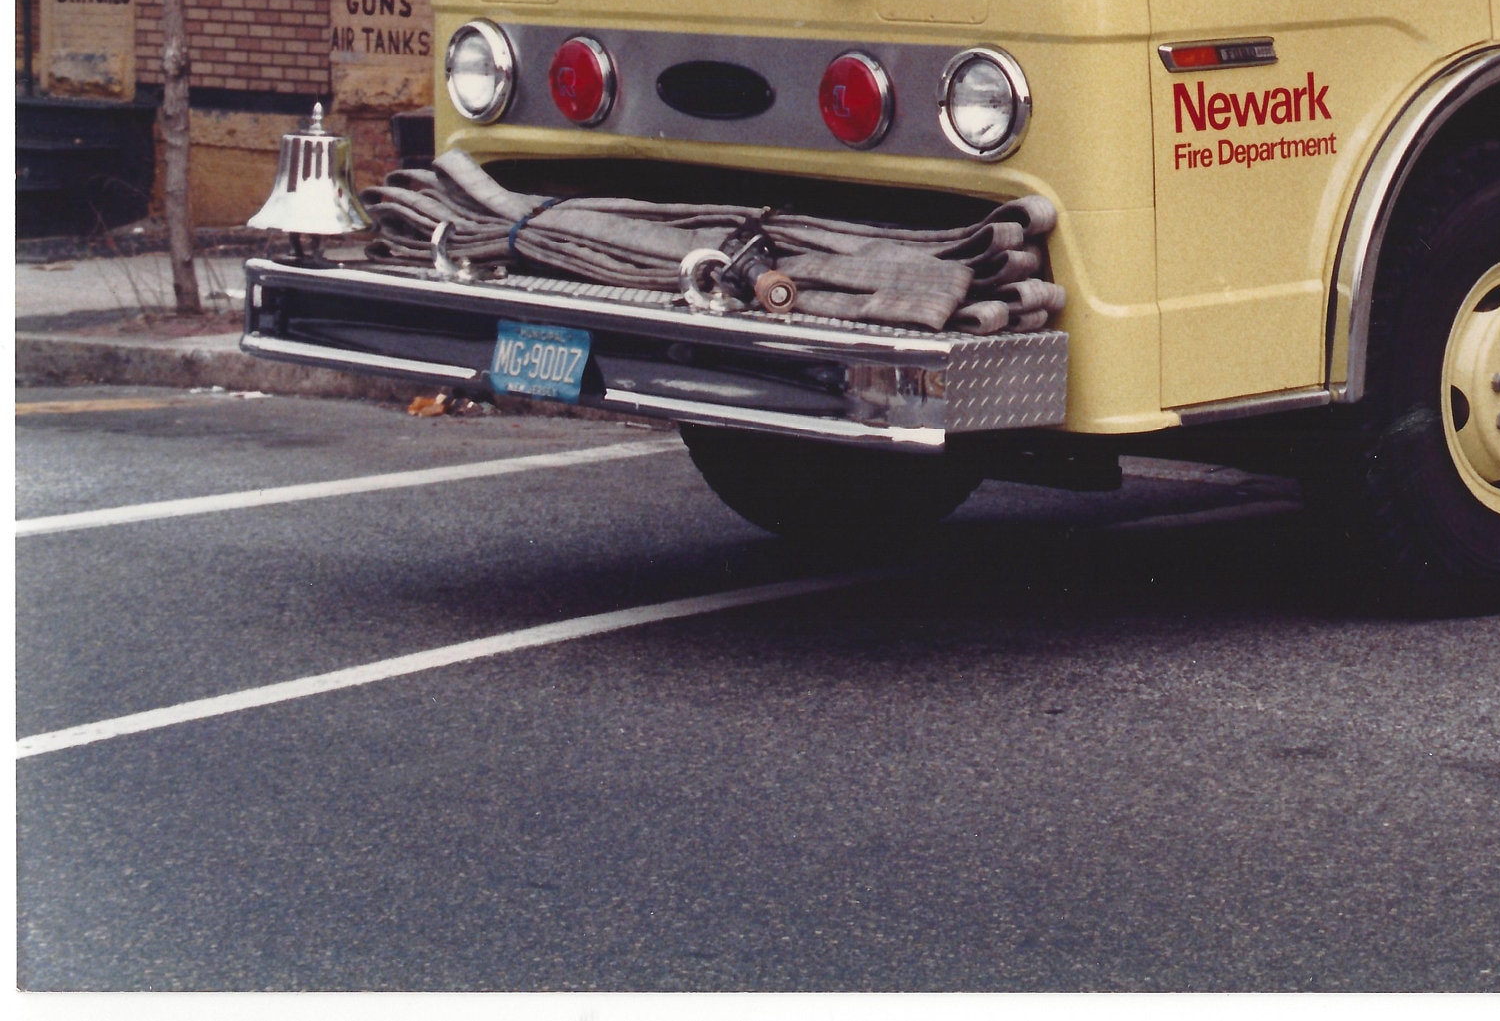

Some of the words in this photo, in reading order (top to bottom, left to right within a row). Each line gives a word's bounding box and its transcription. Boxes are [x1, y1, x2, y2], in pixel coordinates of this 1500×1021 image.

[331, 27, 355, 52] AIR
[361, 26, 431, 57] TANKS
[557, 67, 576, 98] R
[1173, 71, 1332, 134] Newark
[1174, 143, 1213, 170] Fire
[1217, 132, 1337, 168] Department
